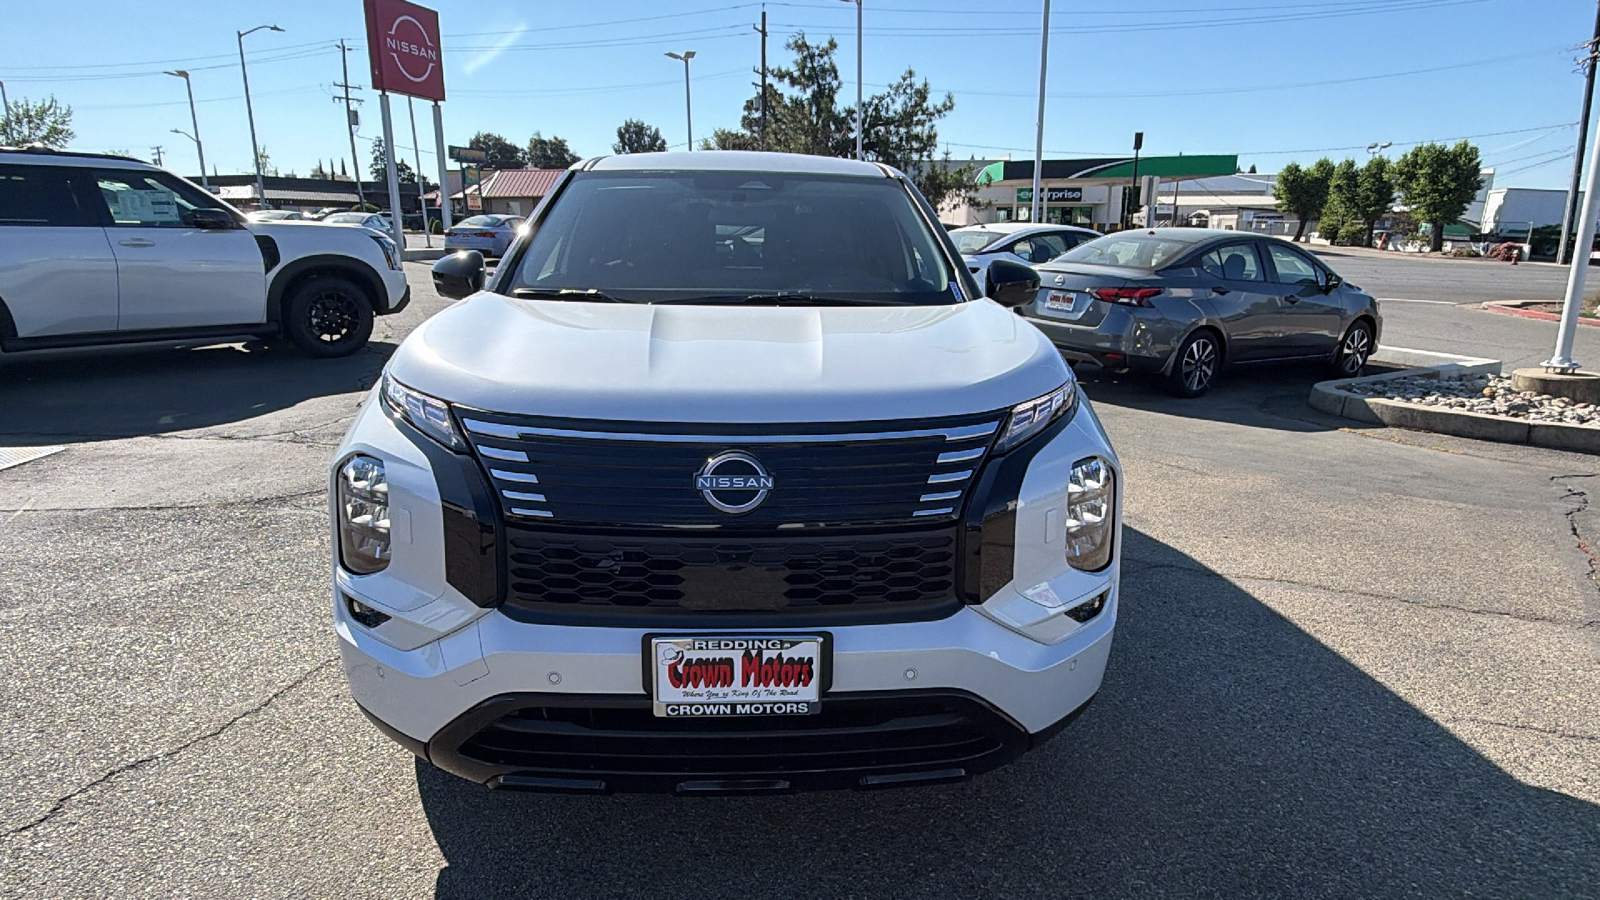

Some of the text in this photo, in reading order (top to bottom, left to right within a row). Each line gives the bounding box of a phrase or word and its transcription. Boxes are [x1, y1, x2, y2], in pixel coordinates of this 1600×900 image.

[386, 37, 436, 60] NISSAN
[698, 477, 773, 488] NISSAN
[694, 640, 782, 650] REDDING
[667, 649, 814, 689] Crown Motors
[682, 690, 704, 698] Where
[731, 690, 749, 698] King
[751, 689, 762, 698] Of
[667, 702, 809, 716] CROWN MOTORS
